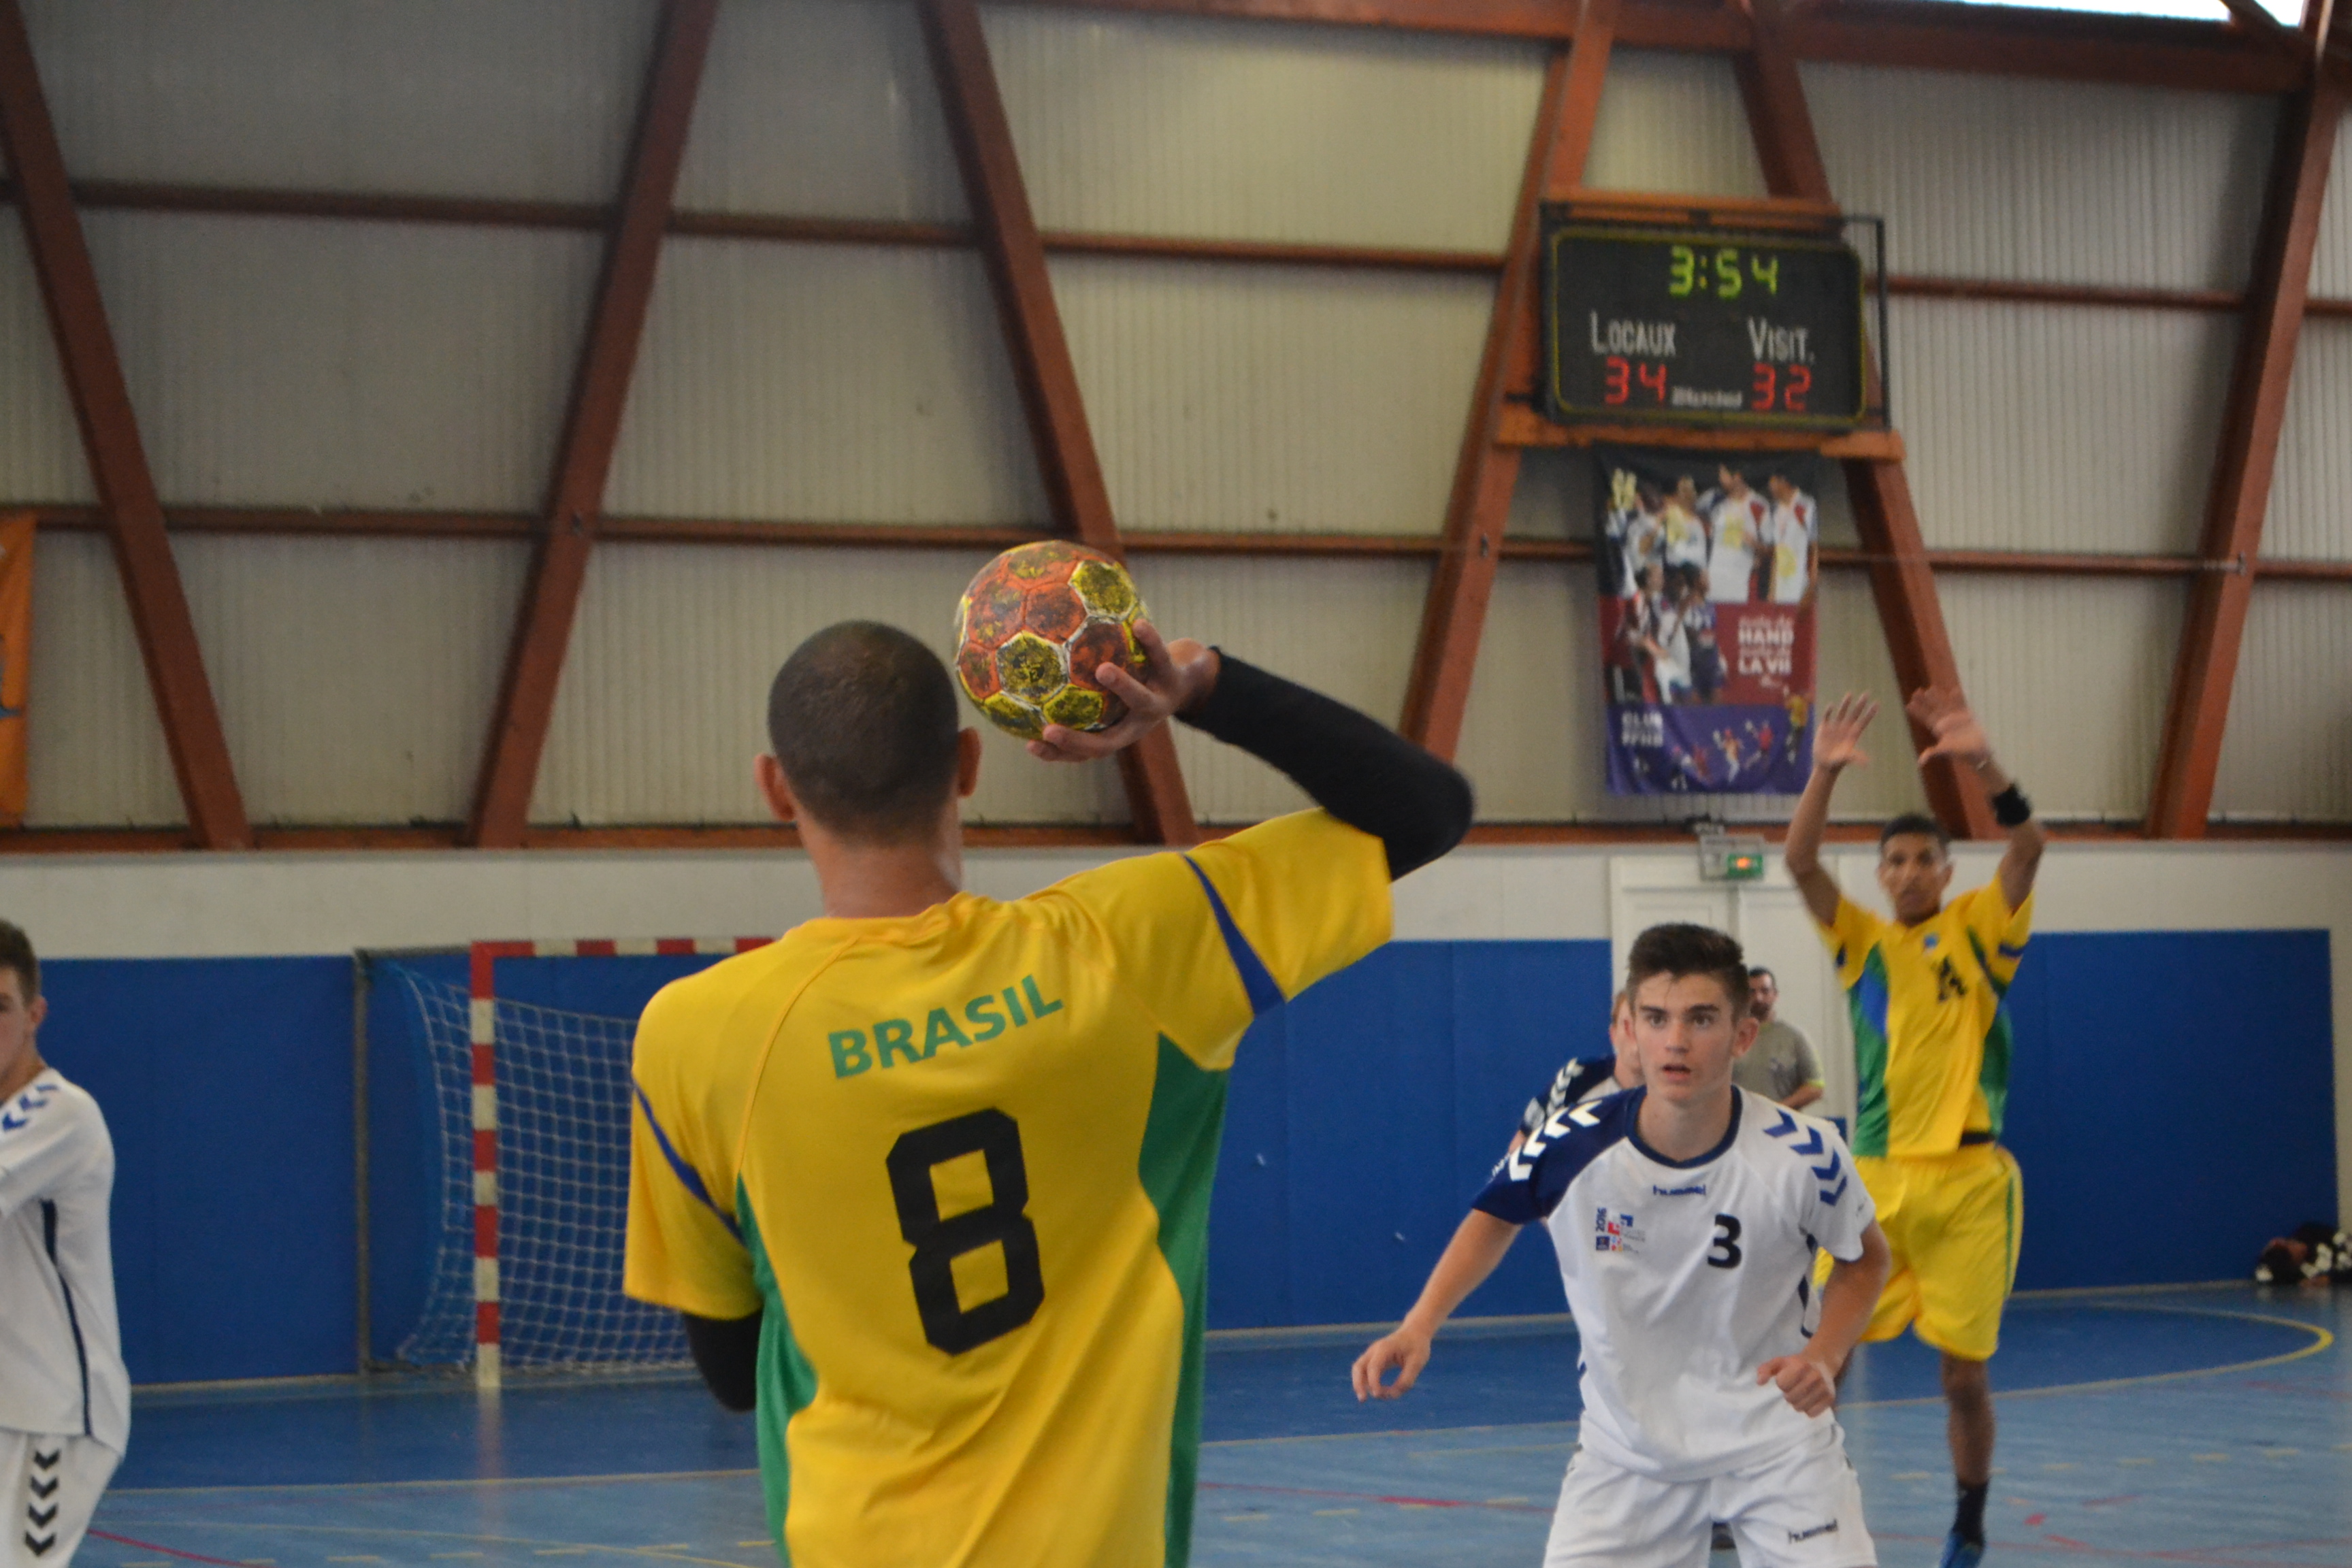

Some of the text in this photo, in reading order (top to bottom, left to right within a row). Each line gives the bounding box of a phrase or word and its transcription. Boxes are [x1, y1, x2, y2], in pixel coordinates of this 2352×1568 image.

[1668, 245, 1778, 299] 3:54
[1605, 355, 1667, 406] 34
[1752, 361, 1812, 411] 32
[828, 974, 1063, 1079] BRASIL
[1652, 1184, 1706, 1196] hummel
[885, 1107, 1045, 1357] 8
[1707, 1213, 1742, 1269] 3
[1788, 1518, 1838, 1544] hummel
